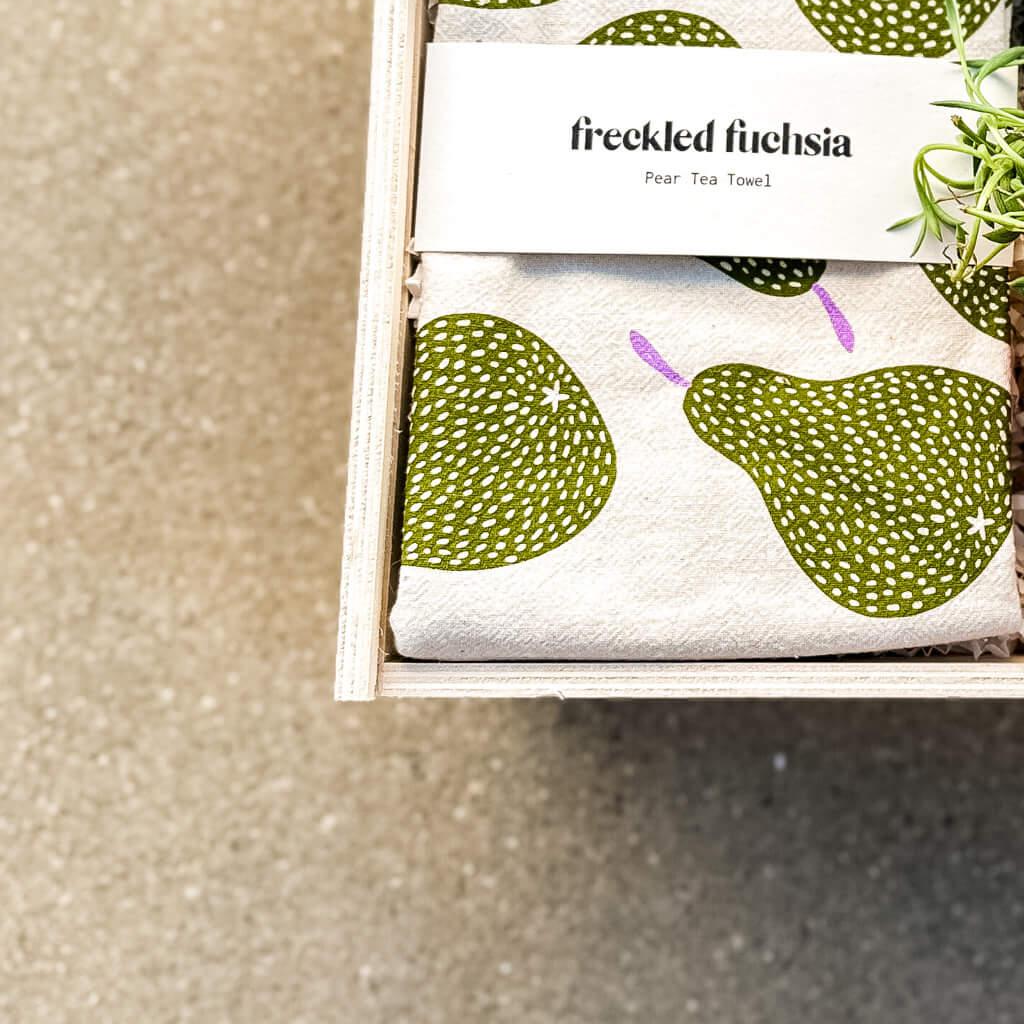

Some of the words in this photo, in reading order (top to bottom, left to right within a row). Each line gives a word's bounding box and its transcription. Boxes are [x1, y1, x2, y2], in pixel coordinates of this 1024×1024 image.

[570, 115, 715, 152] freckled
[725, 118, 853, 157] fuchsia
[644, 171, 681, 185] Pear
[690, 172, 718, 186] Tea
[727, 172, 772, 187] Towel
